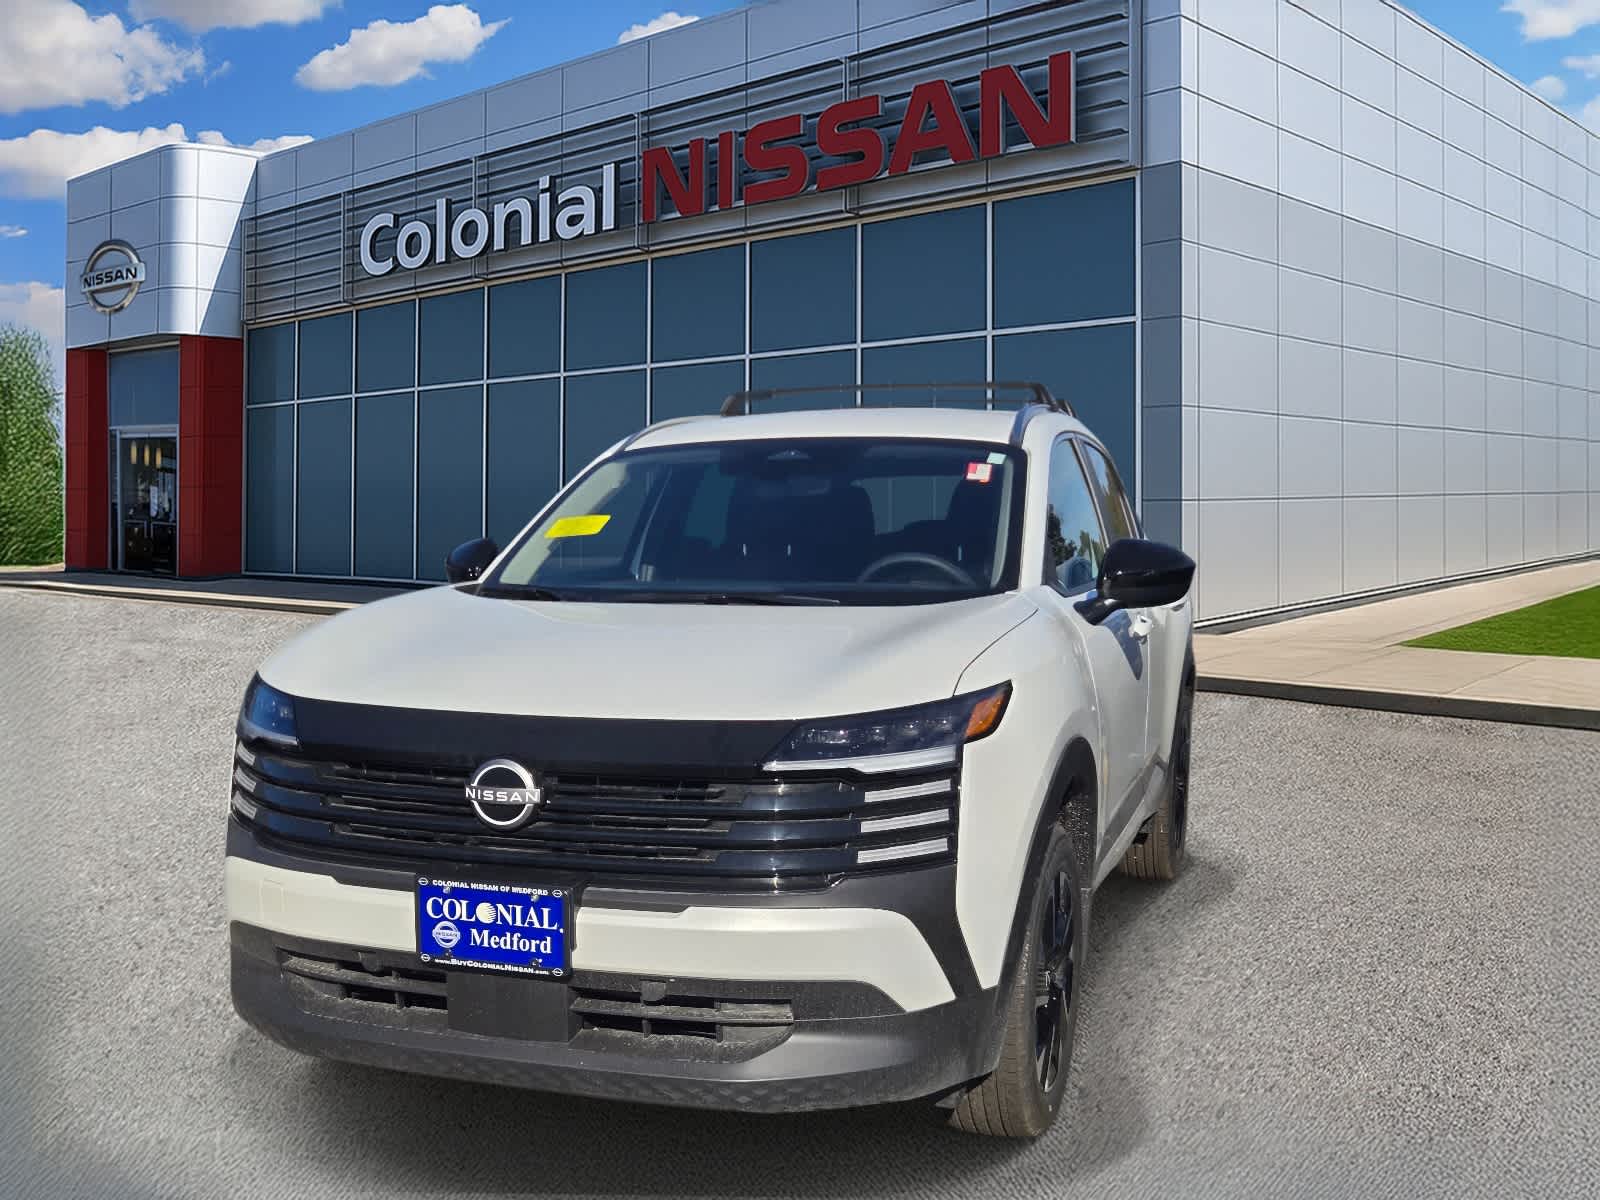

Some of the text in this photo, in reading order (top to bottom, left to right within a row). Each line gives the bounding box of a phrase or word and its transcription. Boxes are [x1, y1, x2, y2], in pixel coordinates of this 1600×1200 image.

[360, 51, 1076, 276] Colonial NISSAN
[83, 267, 137, 289] NISSAN
[465, 787, 539, 802] NISSAN
[432, 879, 549, 896] COLONIAL NISSAN OF MEDFORD
[470, 928, 552, 954] Medford
